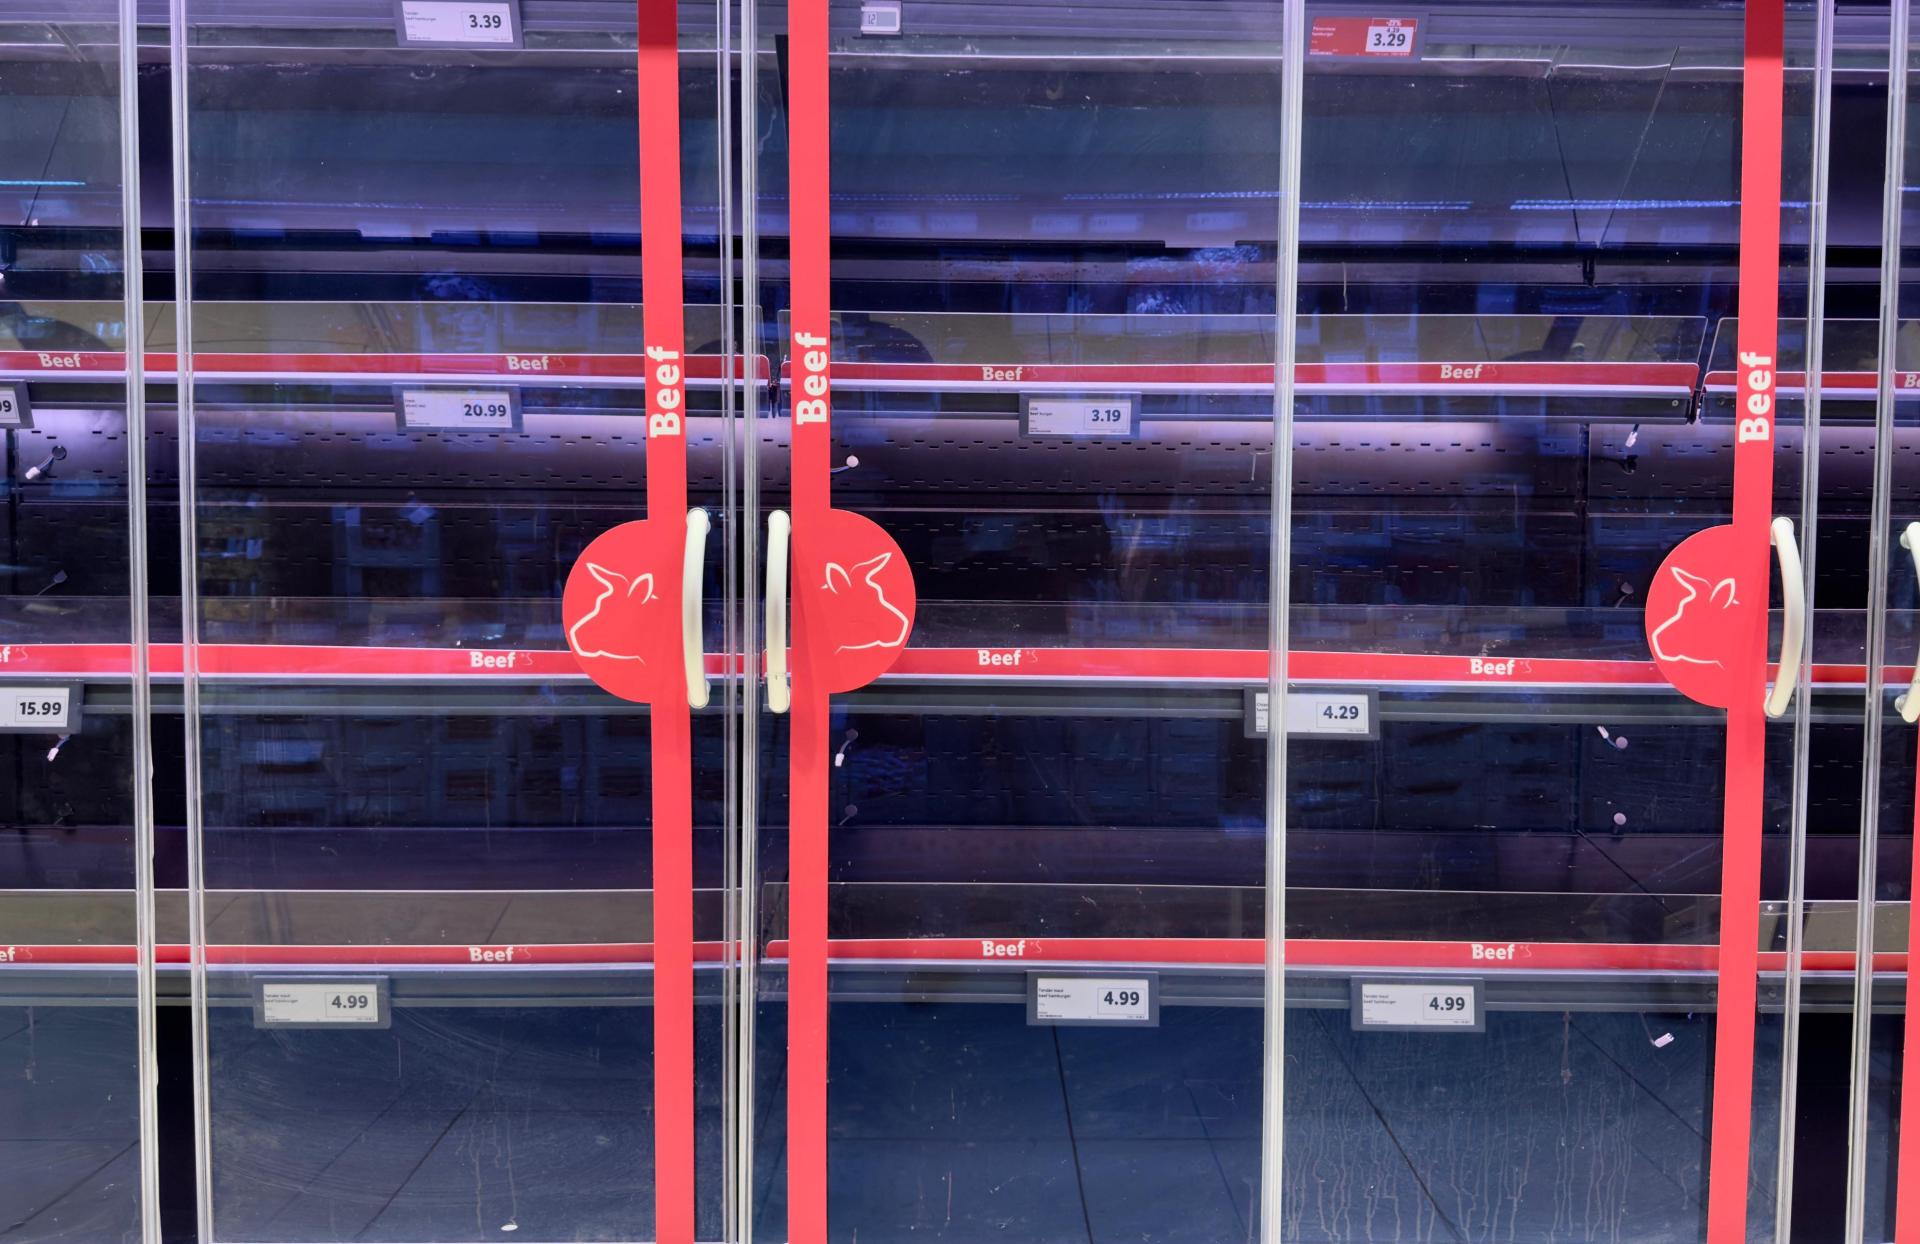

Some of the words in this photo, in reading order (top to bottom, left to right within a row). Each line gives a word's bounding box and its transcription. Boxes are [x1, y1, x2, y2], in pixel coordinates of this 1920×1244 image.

[469, 14, 502, 29] 3.39
[1373, 32, 1406, 47] 3.29
[38, 353, 81, 368] Beef
[505, 355, 549, 371] Beef
[793, 332, 828, 426] Beef
[981, 366, 1023, 381] Beef
[1439, 364, 1483, 379] Beef
[646, 346, 681, 438] Beef
[1738, 351, 1772, 444] Beef
[463, 403, 507, 417] 20.99
[1091, 409, 1121, 422] 3.19
[469, 651, 516, 668] Beef
[977, 649, 1022, 666] Beef
[1470, 658, 1516, 676] Beef
[20, 702, 62, 716] 15.99
[1323, 705, 1359, 720] 4.29
[468, 946, 514, 962] Beef
[981, 940, 1026, 957] Beef
[1471, 943, 1516, 960] Beef
[332, 995, 368, 1009] 4.99
[1104, 991, 1140, 1006] 4.99
[1429, 996, 1466, 1011] 4.99
